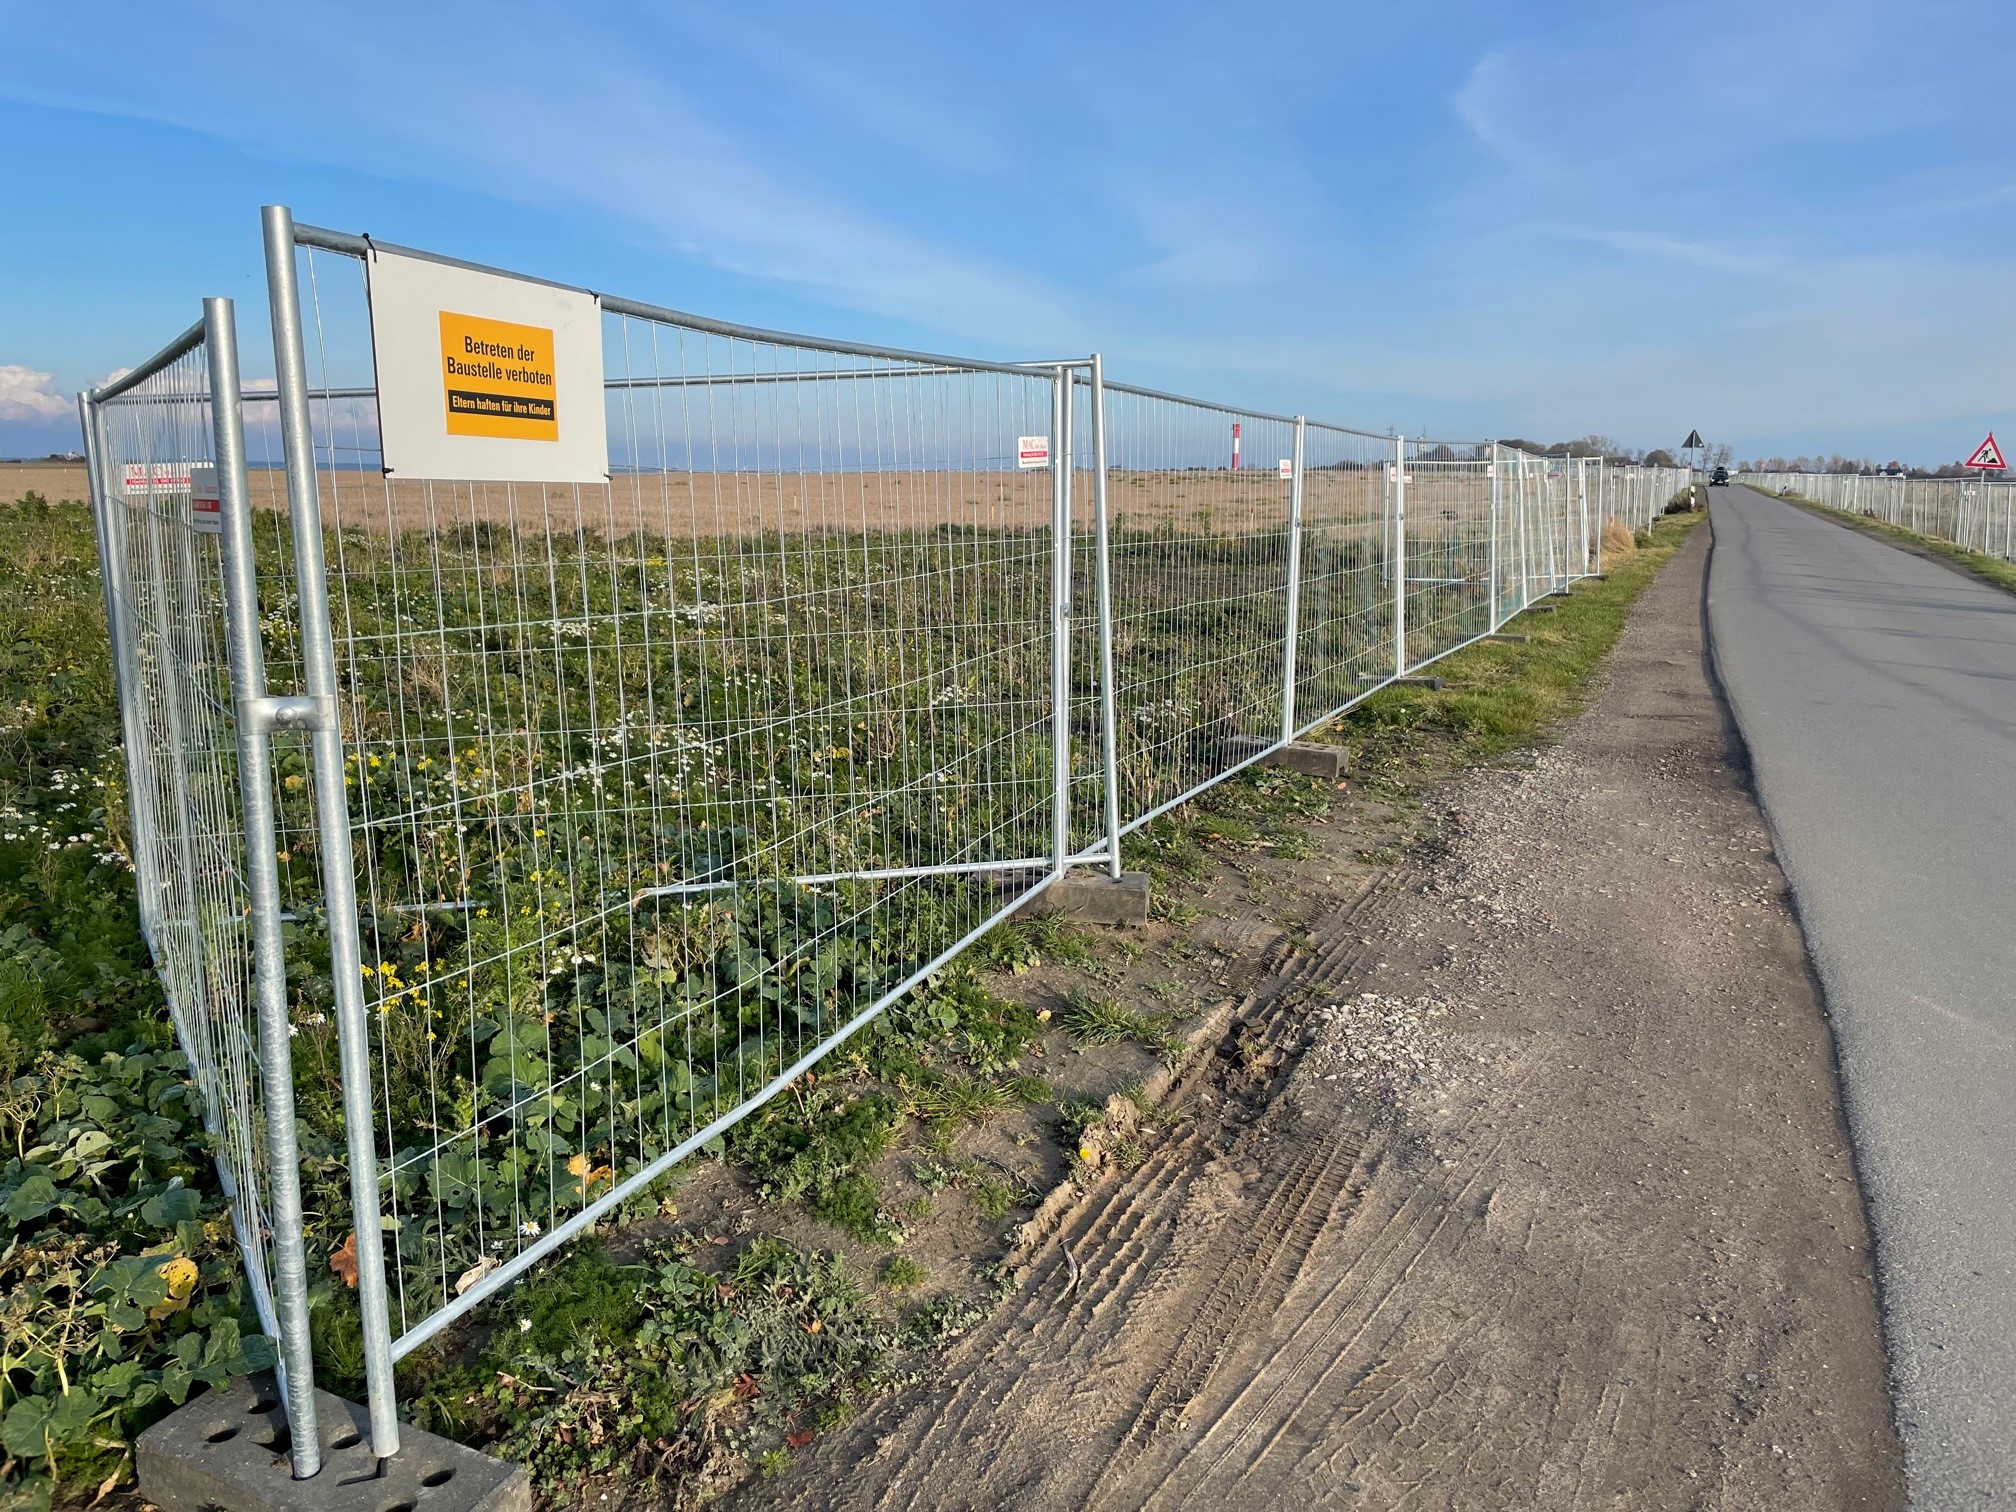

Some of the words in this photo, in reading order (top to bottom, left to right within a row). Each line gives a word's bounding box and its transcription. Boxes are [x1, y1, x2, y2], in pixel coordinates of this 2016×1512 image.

[464, 335, 514, 359] Betreten
[517, 344, 535, 362] der
[447, 356, 502, 380] Baustelle
[505, 366, 552, 385] verboten
[452, 395, 476, 409] Eltern
[476, 398, 500, 412] haften
[501, 400, 512, 413] für
[513, 402, 527, 414] ihre
[528, 403, 551, 416] Kinder
